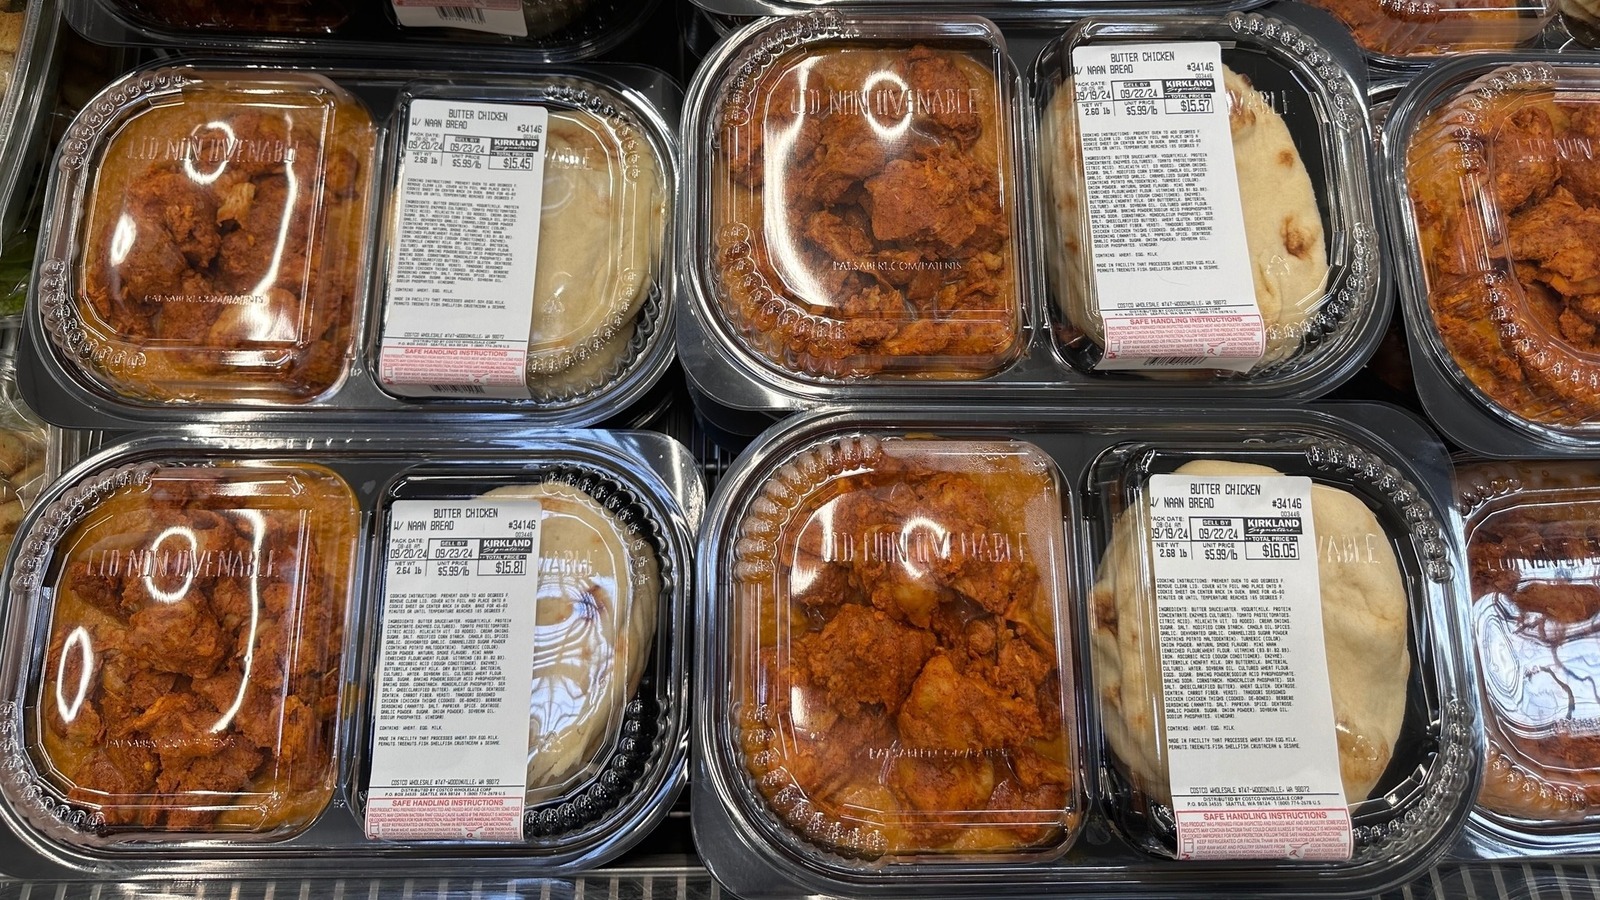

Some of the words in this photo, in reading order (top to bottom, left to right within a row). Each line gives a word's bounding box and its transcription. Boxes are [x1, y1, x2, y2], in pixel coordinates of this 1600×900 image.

[1110, 52, 1139, 63] BUTTER
[1142, 51, 1175, 62] CHICKEN
[1087, 66, 1107, 75] NAAN
[1110, 64, 1134, 74] BREAD
[1187, 62, 1214, 72] #34146
[1166, 80, 1213, 88] KIRKLAND
[1076, 91, 1111, 101] 09/19/24
[1120, 89, 1158, 99] 09/22/24
[1126, 106, 1158, 116] $5.99/lb
[1181, 100, 1211, 112] $15.57
[448, 109, 475, 120] BUTTER
[478, 110, 508, 122] CHICKEN
[1085, 108, 1100, 116] 2.60
[412, 118, 422, 127] W/
[425, 119, 443, 128] NAAN
[446, 120, 468, 130] BREAD
[517, 124, 543, 134] #34146
[408, 141, 443, 151] 09/20/24
[494, 139, 538, 147] KIRKLAND
[450, 143, 485, 154] 09/23/24
[503, 158, 531, 170] $15.45
[425, 349, 458, 357] HANDLING
[1190, 484, 1221, 495] BUTTER
[1225, 484, 1261, 495] CHICKEN
[1164, 497, 1184, 508] NAAN
[1188, 498, 1214, 509] BREAD
[1272, 498, 1302, 509] #34146
[434, 509, 461, 519] BUTTER
[466, 508, 499, 518] CHICKEN
[394, 522, 404, 531] W/
[407, 522, 427, 531] NAAN
[430, 521, 455, 531] BREAD
[509, 520, 536, 530] #34146
[1248, 519, 1300, 528] KIRKLAND
[1199, 528, 1238, 540] 09/22/24
[390, 549, 428, 559] 09/20/24
[435, 549, 473, 559] 09/23/24
[1160, 549, 1176, 558] 2.68
[1179, 549, 1188, 557] lb
[1205, 549, 1238, 561] $5.99/lb
[1262, 544, 1297, 559] $16.05
[396, 567, 411, 575] 2.64
[415, 567, 422, 575] lb
[438, 566, 470, 577] $5.99/lb
[496, 561, 524, 575] $15.81
[1204, 813, 1225, 821] SAFE
[1226, 812, 1268, 820] HANDLING
[1269, 812, 1328, 820] INSTRUCTIONS
